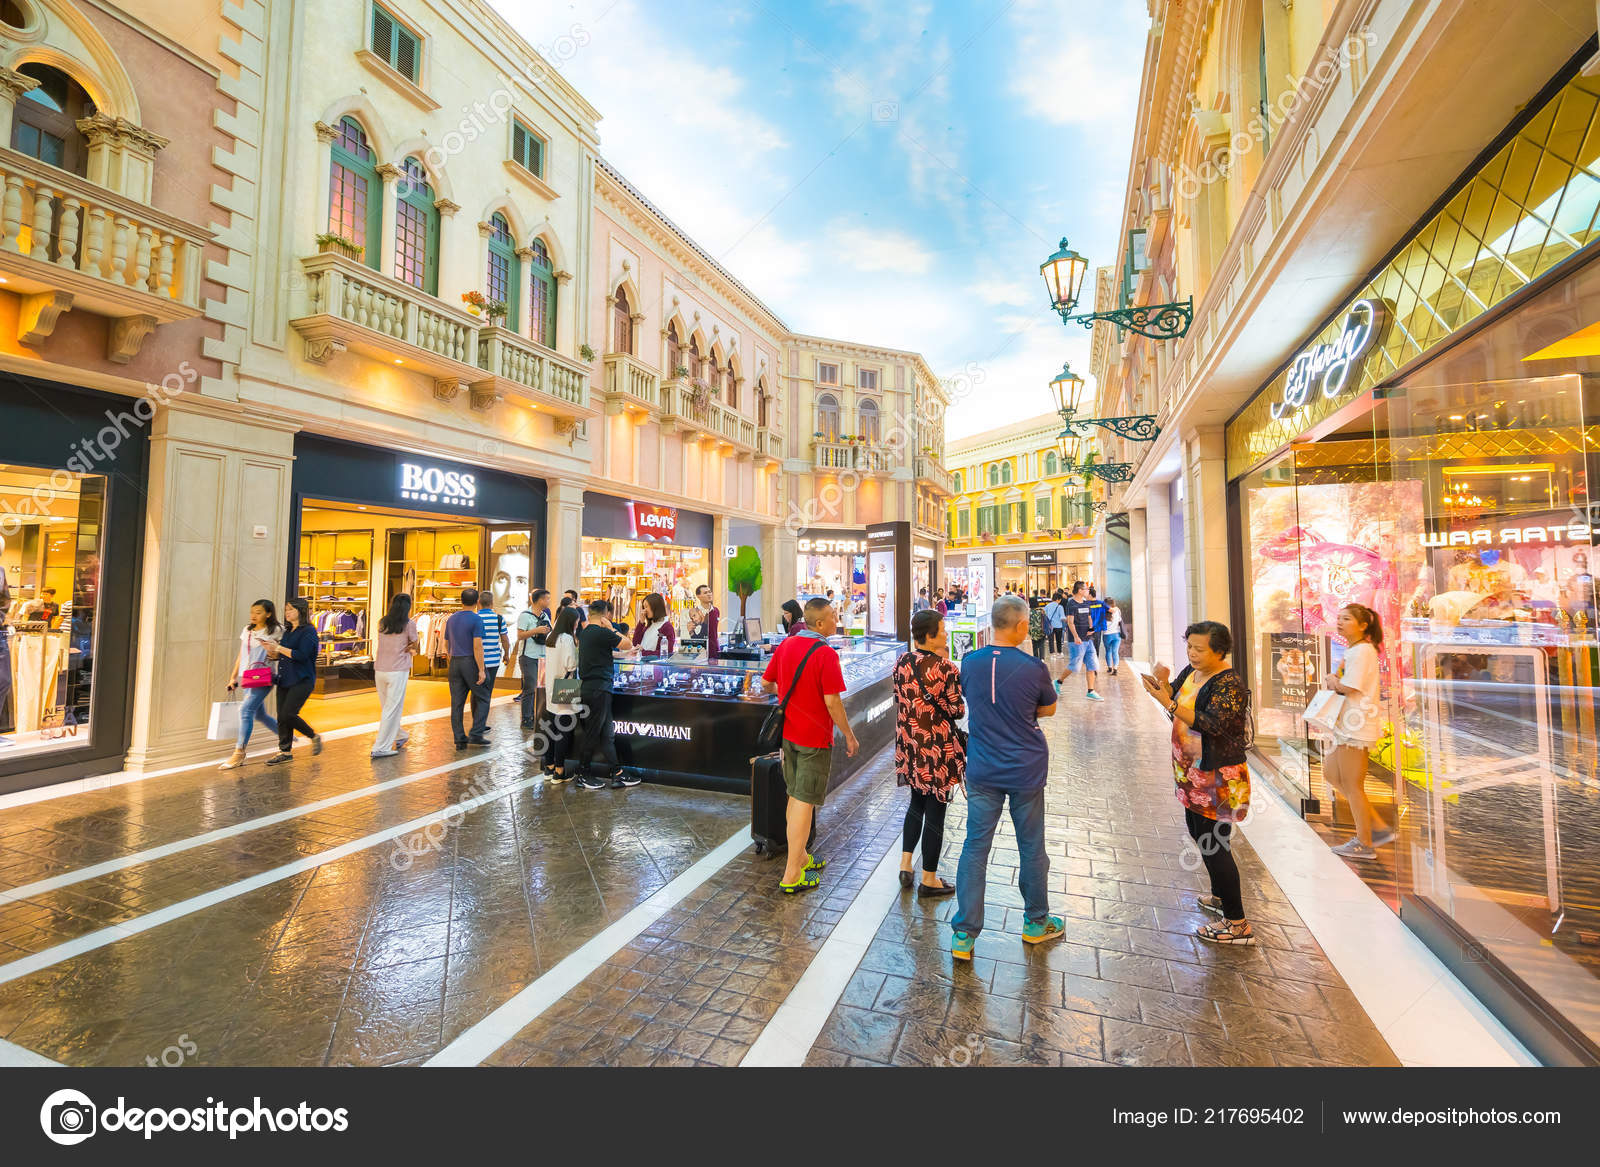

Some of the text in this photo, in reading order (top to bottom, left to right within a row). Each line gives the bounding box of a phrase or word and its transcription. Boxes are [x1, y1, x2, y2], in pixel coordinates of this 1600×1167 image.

[400, 463, 477, 499] BOSS
[1281, 687, 1309, 697] NEW
[647, 723, 692, 740] ARMANI
